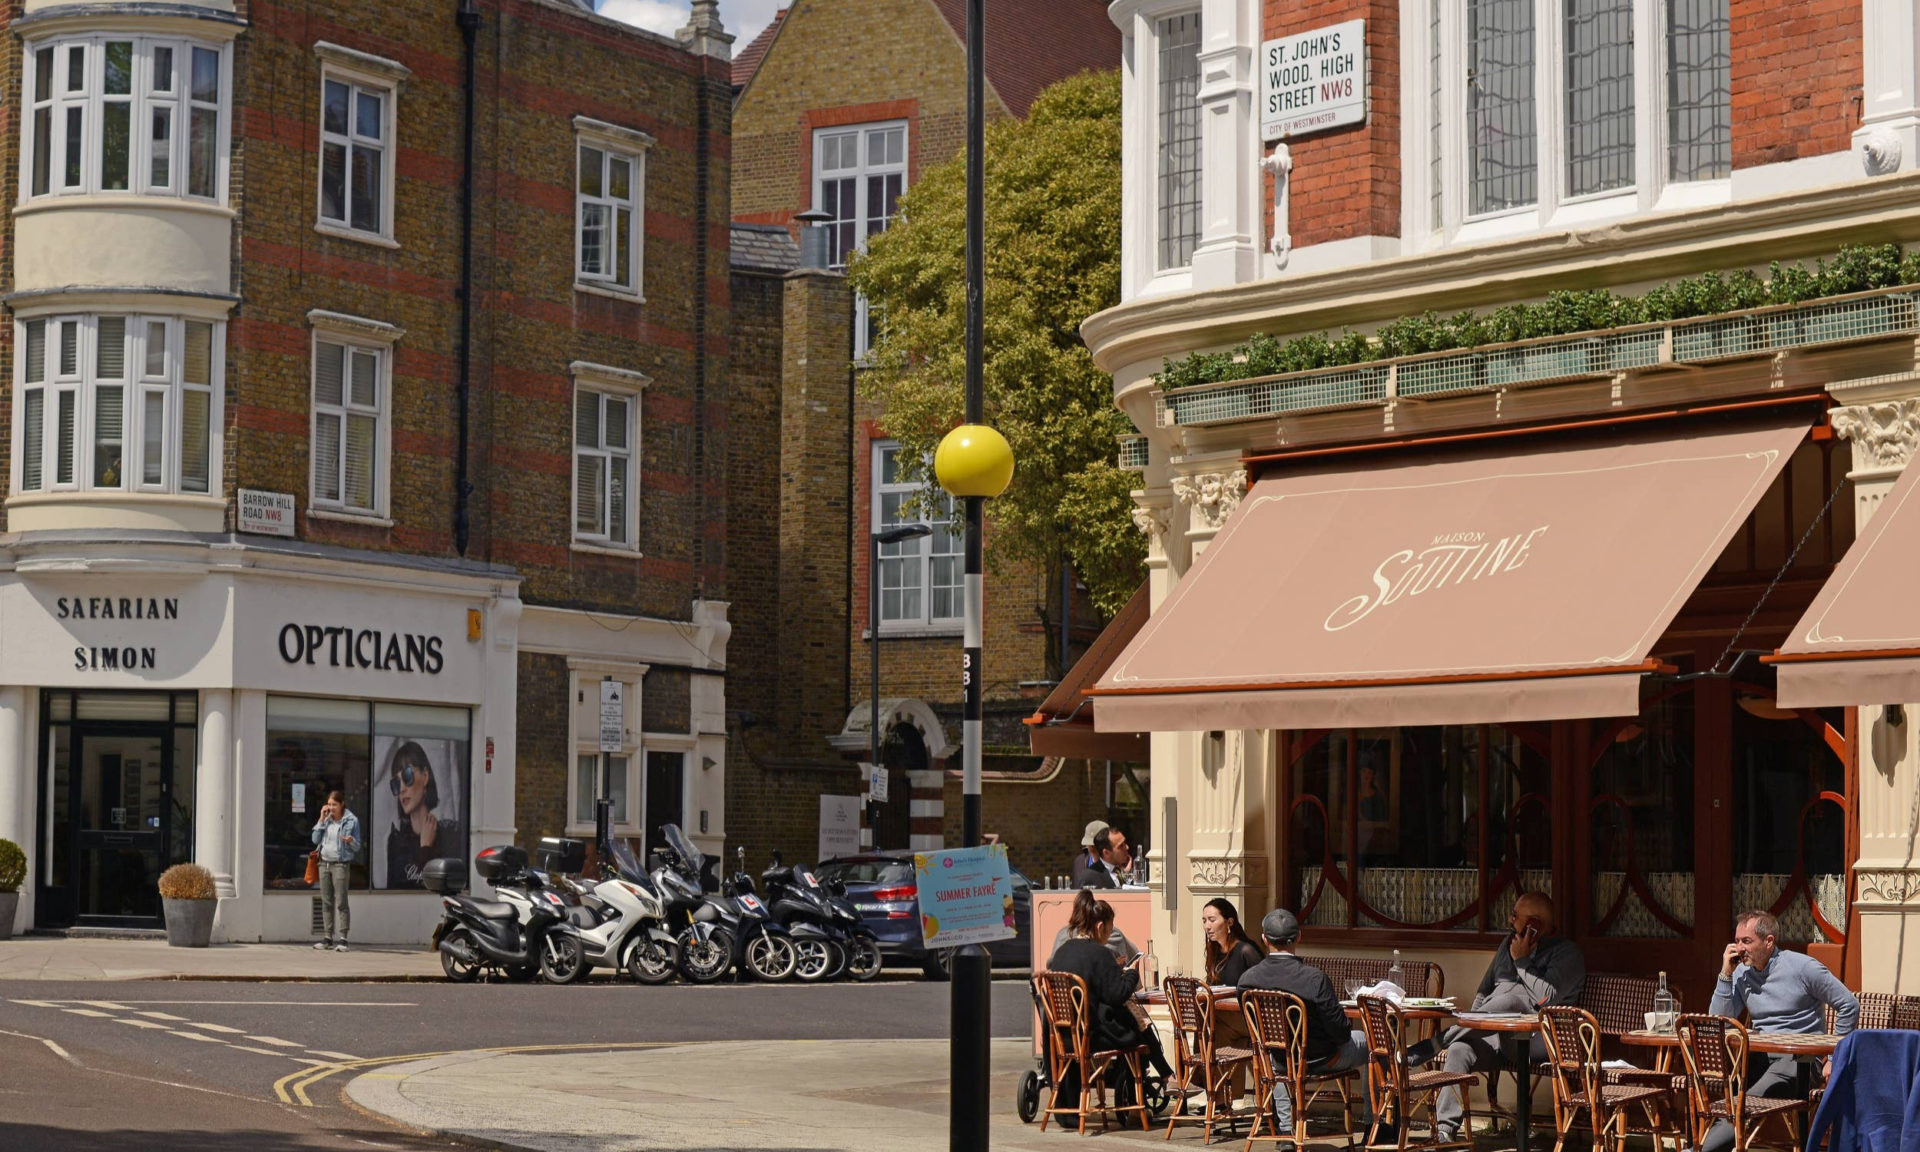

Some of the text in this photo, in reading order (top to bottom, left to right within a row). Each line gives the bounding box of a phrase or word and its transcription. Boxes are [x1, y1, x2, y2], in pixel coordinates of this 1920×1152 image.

[1269, 32, 1341, 66] ST. JOHN'S
[1269, 52, 1354, 89] WOOD. HIGH
[1269, 77, 1353, 113] STREET NW8
[1269, 112, 1336, 135] CITY OF WESTMINSTER
[243, 493, 291, 510] BARROW HILL
[243, 506, 282, 521] ROAD NW8
[1431, 532, 1486, 545] MAISON
[1323, 524, 1550, 631] SOUTINE
[57, 597, 178, 620] SAFARIAN
[74, 646, 156, 669] SIMON
[278, 622, 444, 675] OPTICIANS
[936, 883, 997, 903] SUMMER FAYRE
